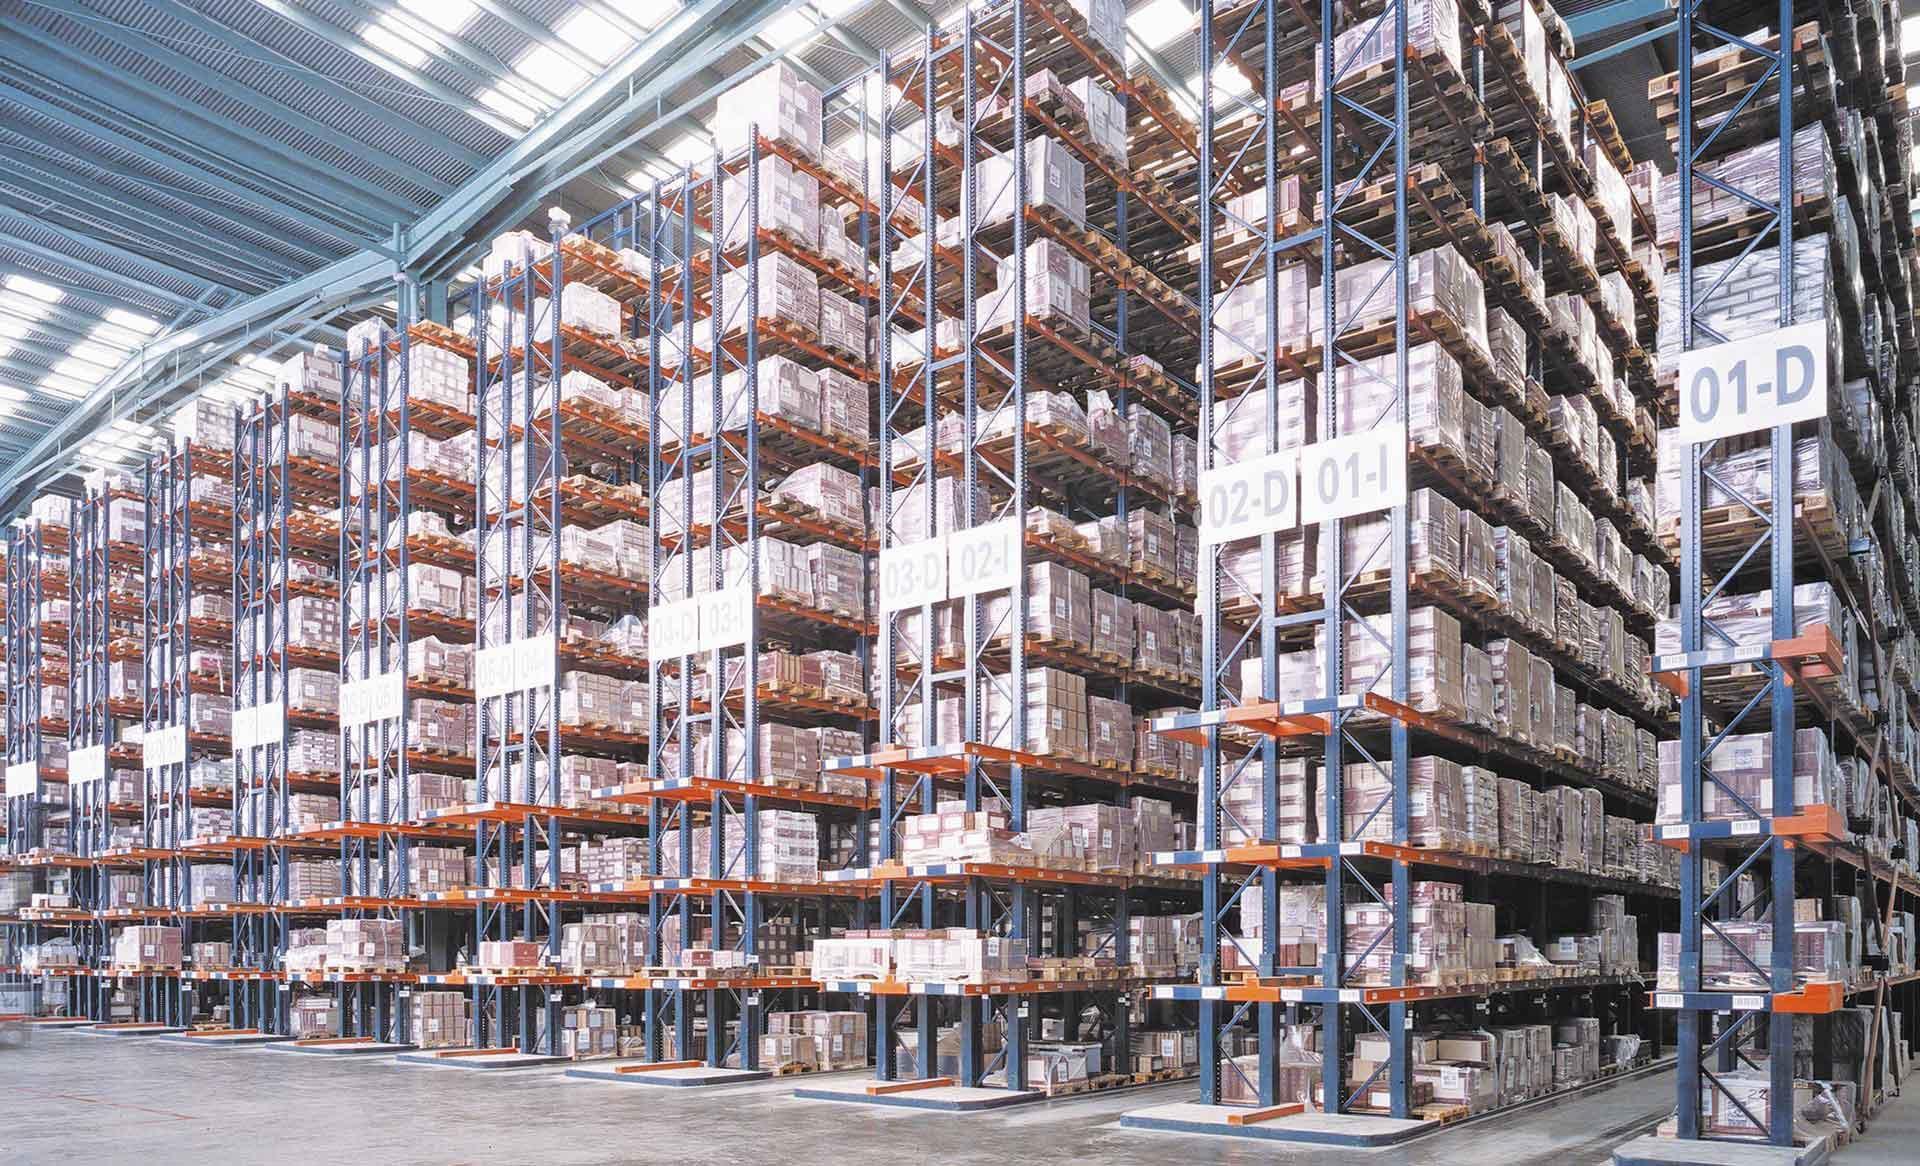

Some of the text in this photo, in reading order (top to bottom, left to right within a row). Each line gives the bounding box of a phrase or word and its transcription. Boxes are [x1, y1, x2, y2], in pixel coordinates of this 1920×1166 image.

[1690, 345, 1815, 423] 01-D
[1208, 470, 1289, 529] 02-D
[1318, 443, 1388, 505] 01-I
[885, 552, 941, 599] 03-D
